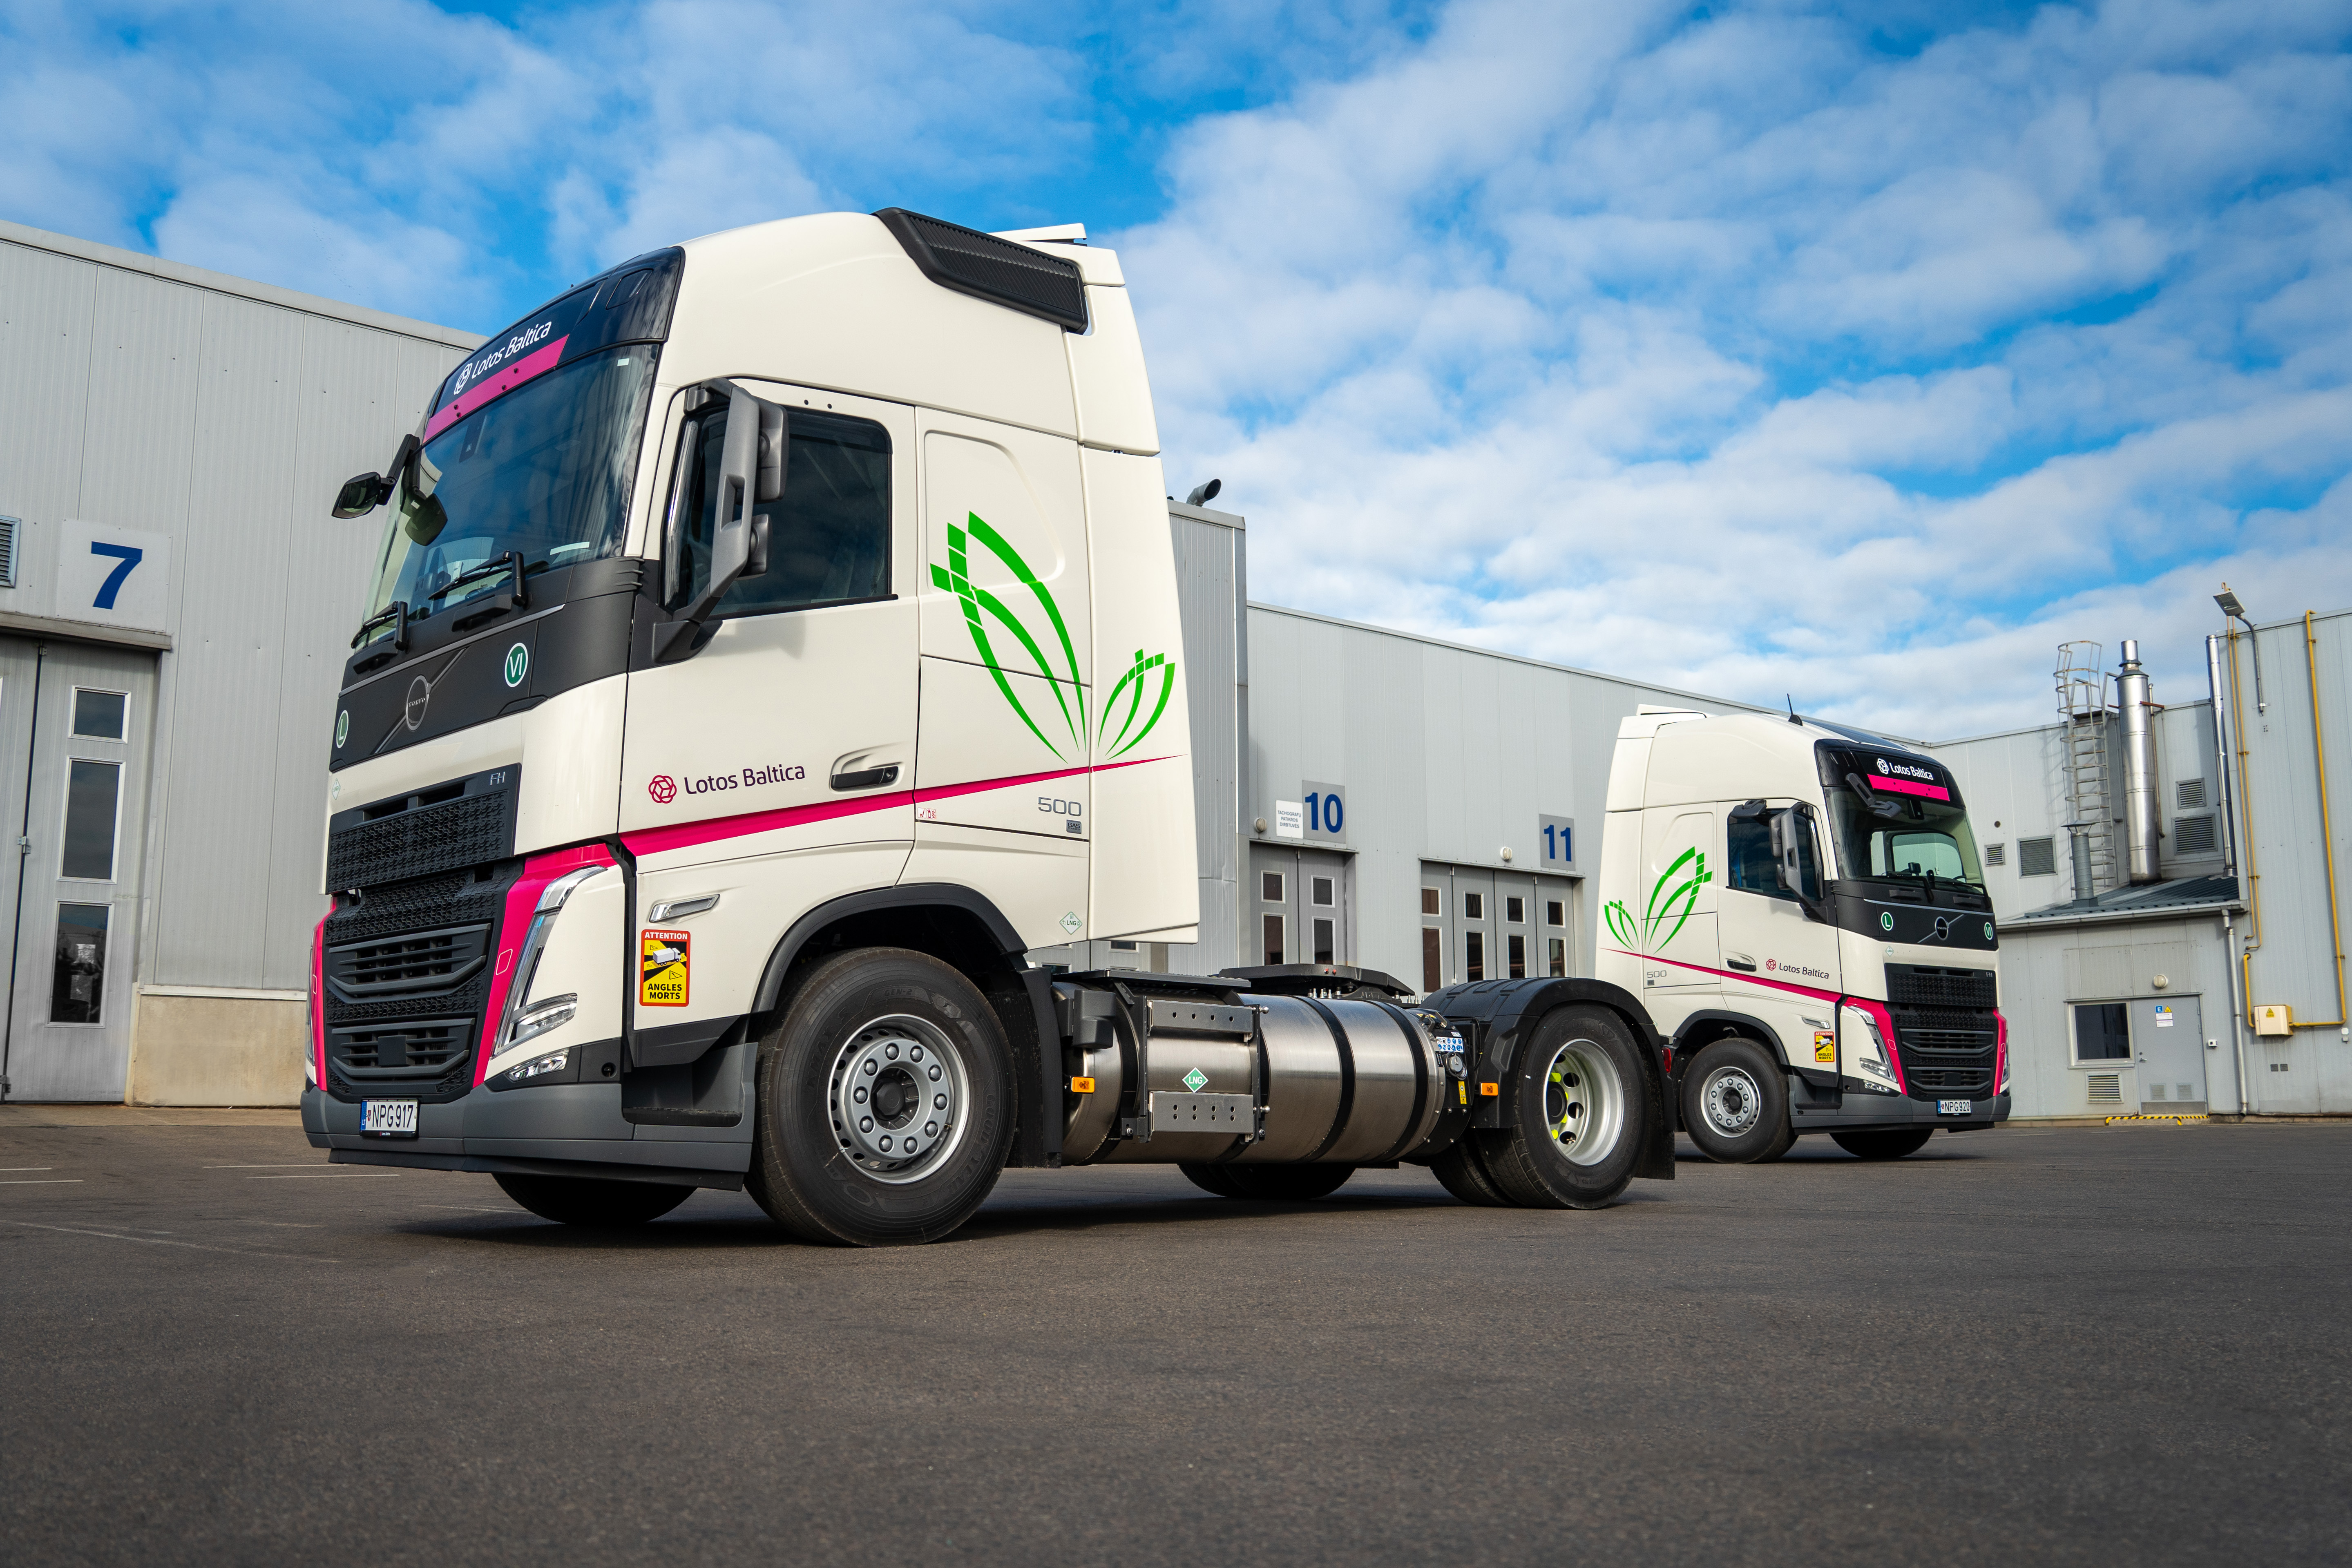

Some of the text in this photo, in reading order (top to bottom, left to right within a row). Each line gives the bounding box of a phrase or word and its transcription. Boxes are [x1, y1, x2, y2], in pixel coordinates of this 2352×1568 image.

[471, 321, 552, 379] Lotos Baltica
[91, 541, 143, 610] 7
[509, 652, 523, 678] VI
[409, 697, 425, 707] VOLVO
[339, 719, 344, 741] L
[490, 771, 505, 785] FH
[684, 764, 805, 795] Lotos Baltica
[1889, 762, 1934, 780] Lotos Baltica
[1038, 797, 1081, 816] 500
[1305, 792, 1343, 833] 10
[1544, 824, 1572, 862] 11
[1885, 916, 1890, 927] L
[1986, 927, 1992, 936] VI
[1779, 963, 1829, 979] Lotos Baltica
[885, 988, 912, 996] GEN-2
[1189, 1076, 1203, 1084] LNG
[1945, 1101, 1970, 1112] NPG920
[372, 1104, 413, 1128] NPG917
